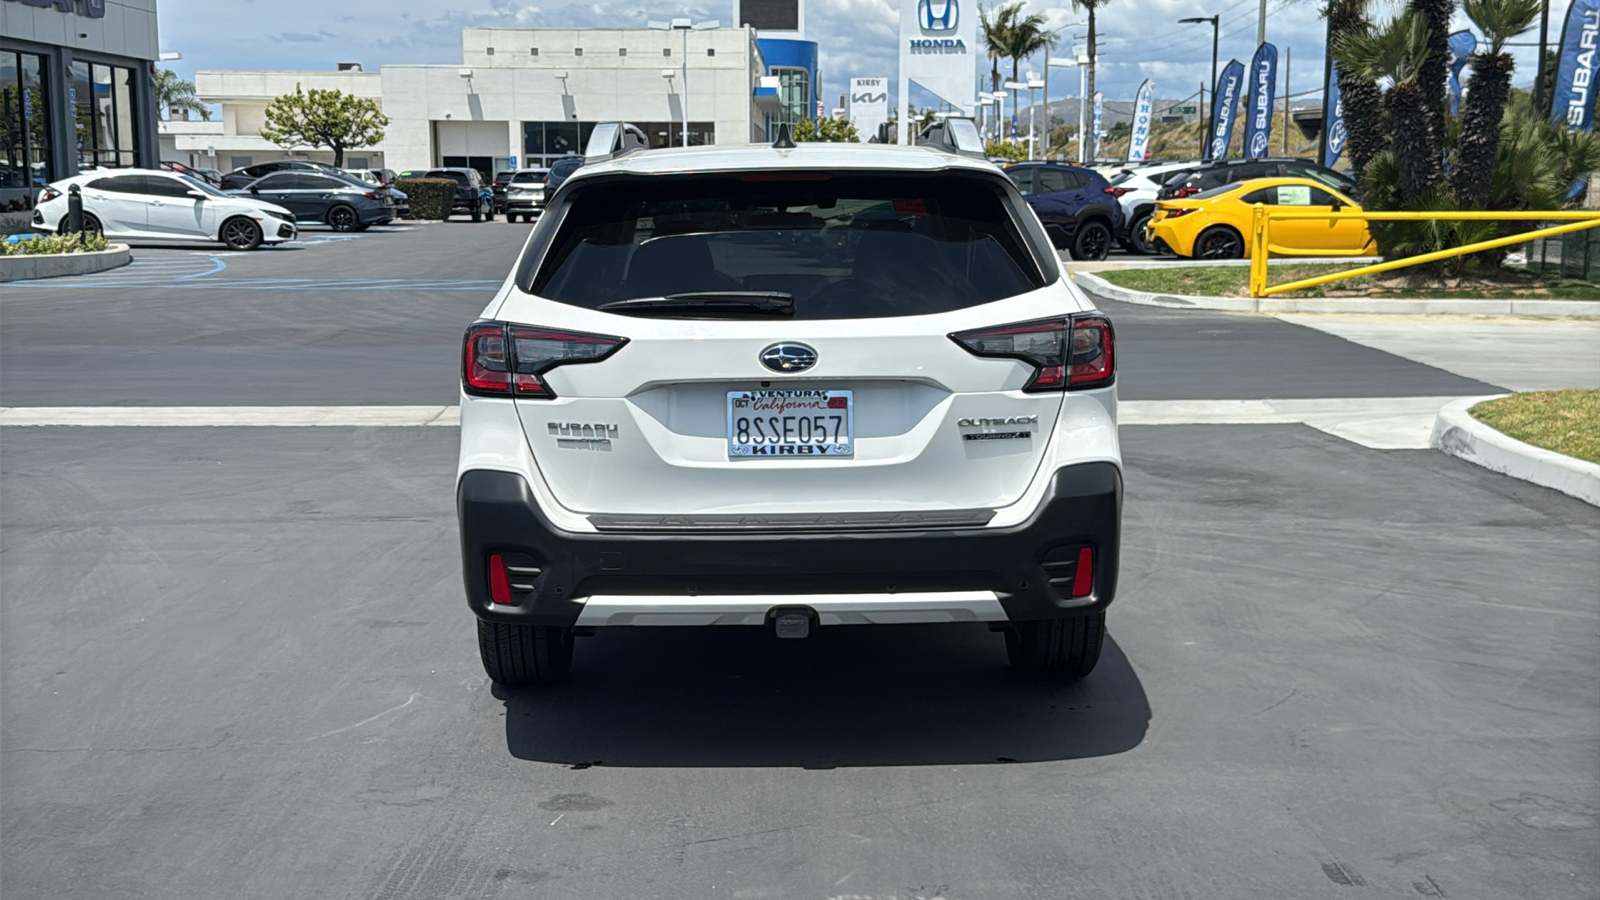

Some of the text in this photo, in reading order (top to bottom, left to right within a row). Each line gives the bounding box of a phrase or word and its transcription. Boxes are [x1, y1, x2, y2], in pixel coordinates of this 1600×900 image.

[909, 39, 966, 49] HONDA
[1567, 10, 1600, 126] SUBARU
[851, 92, 887, 103] KIA
[1255, 61, 1271, 129] SUBARU
[1216, 76, 1237, 137] SUBARU
[1132, 104, 1150, 158] HONDA
[735, 400, 749, 408] OCT
[753, 398, 827, 414] California
[547, 422, 618, 432] SUBARU
[957, 414, 1038, 427] OUTBACK
[737, 416, 842, 444] 8SSE057
[752, 445, 831, 455] KIRBY
